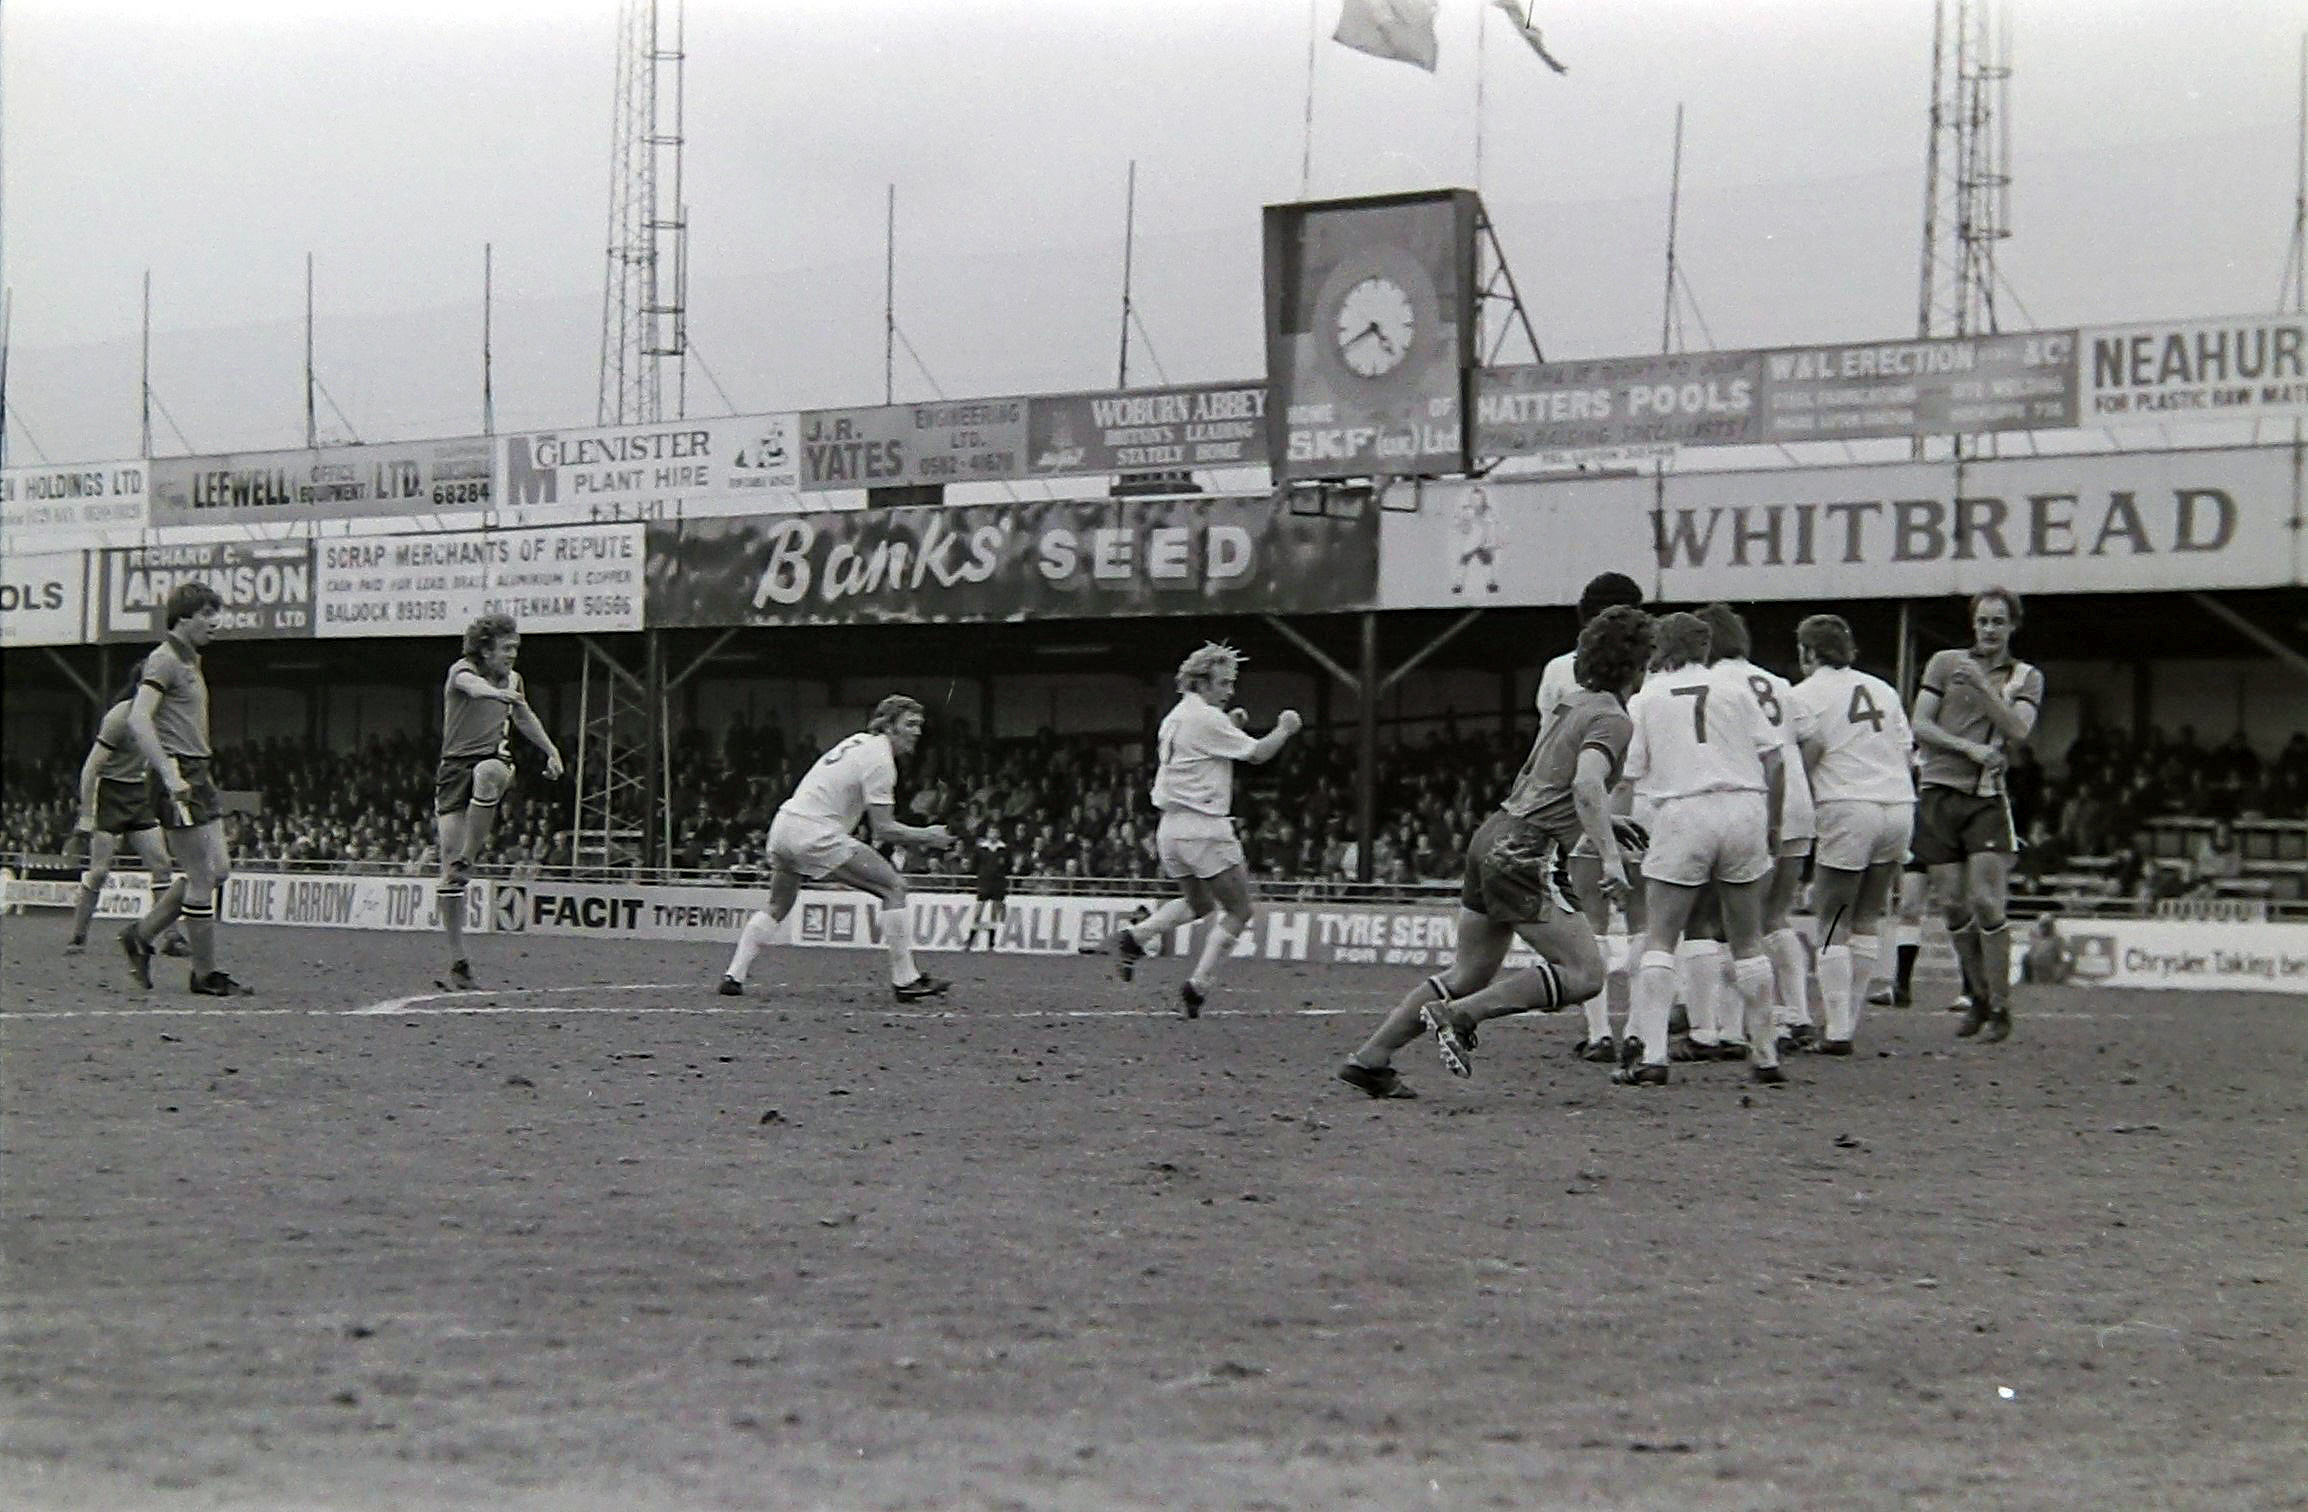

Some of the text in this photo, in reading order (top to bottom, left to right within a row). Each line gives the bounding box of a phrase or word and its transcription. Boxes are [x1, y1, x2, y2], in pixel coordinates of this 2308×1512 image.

[1842, 341, 1976, 377] ERECTION
[2093, 326, 2304, 388] NEAHUR
[915, 402, 1020, 431] ENGINEERING
[1091, 396, 1189, 428] WOBURN
[1193, 389, 1268, 420] ABBEY
[1477, 388, 1611, 424] HATTERS
[1627, 377, 1753, 417] POOLS
[2094, 392, 2129, 413] FOR
[2136, 389, 2206, 411] PLASTIC
[2212, 386, 2253, 406] RAW
[536, 431, 710, 467] GLENISTER
[805, 438, 904, 482] YATES
[1116, 445, 1184, 466] STATELY
[1287, 427, 1375, 462] SKF
[25, 472, 104, 500] HOLDINGS
[374, 460, 425, 499] LTD.
[575, 469, 645, 494] PLANT
[655, 465, 709, 489] HIRE
[1647, 487, 2238, 569] WHITBREAD
[326, 535, 633, 569] SCRAP MERCHANTS OF REPUTE
[1037, 525, 1252, 580] SEED
[274, 610, 307, 630] LTD
[1670, 684, 1710, 744] 7
[1747, 674, 1783, 727] 8
[1847, 683, 1886, 733] 4
[225, 878, 276, 922] BLUE
[284, 881, 357, 925] ARROW
[386, 884, 423, 926] TOP
[533, 894, 644, 930] FACIT
[1264, 911, 1310, 960] H
[1316, 912, 1388, 946] TYRE
[1391, 914, 1459, 949] SERV
